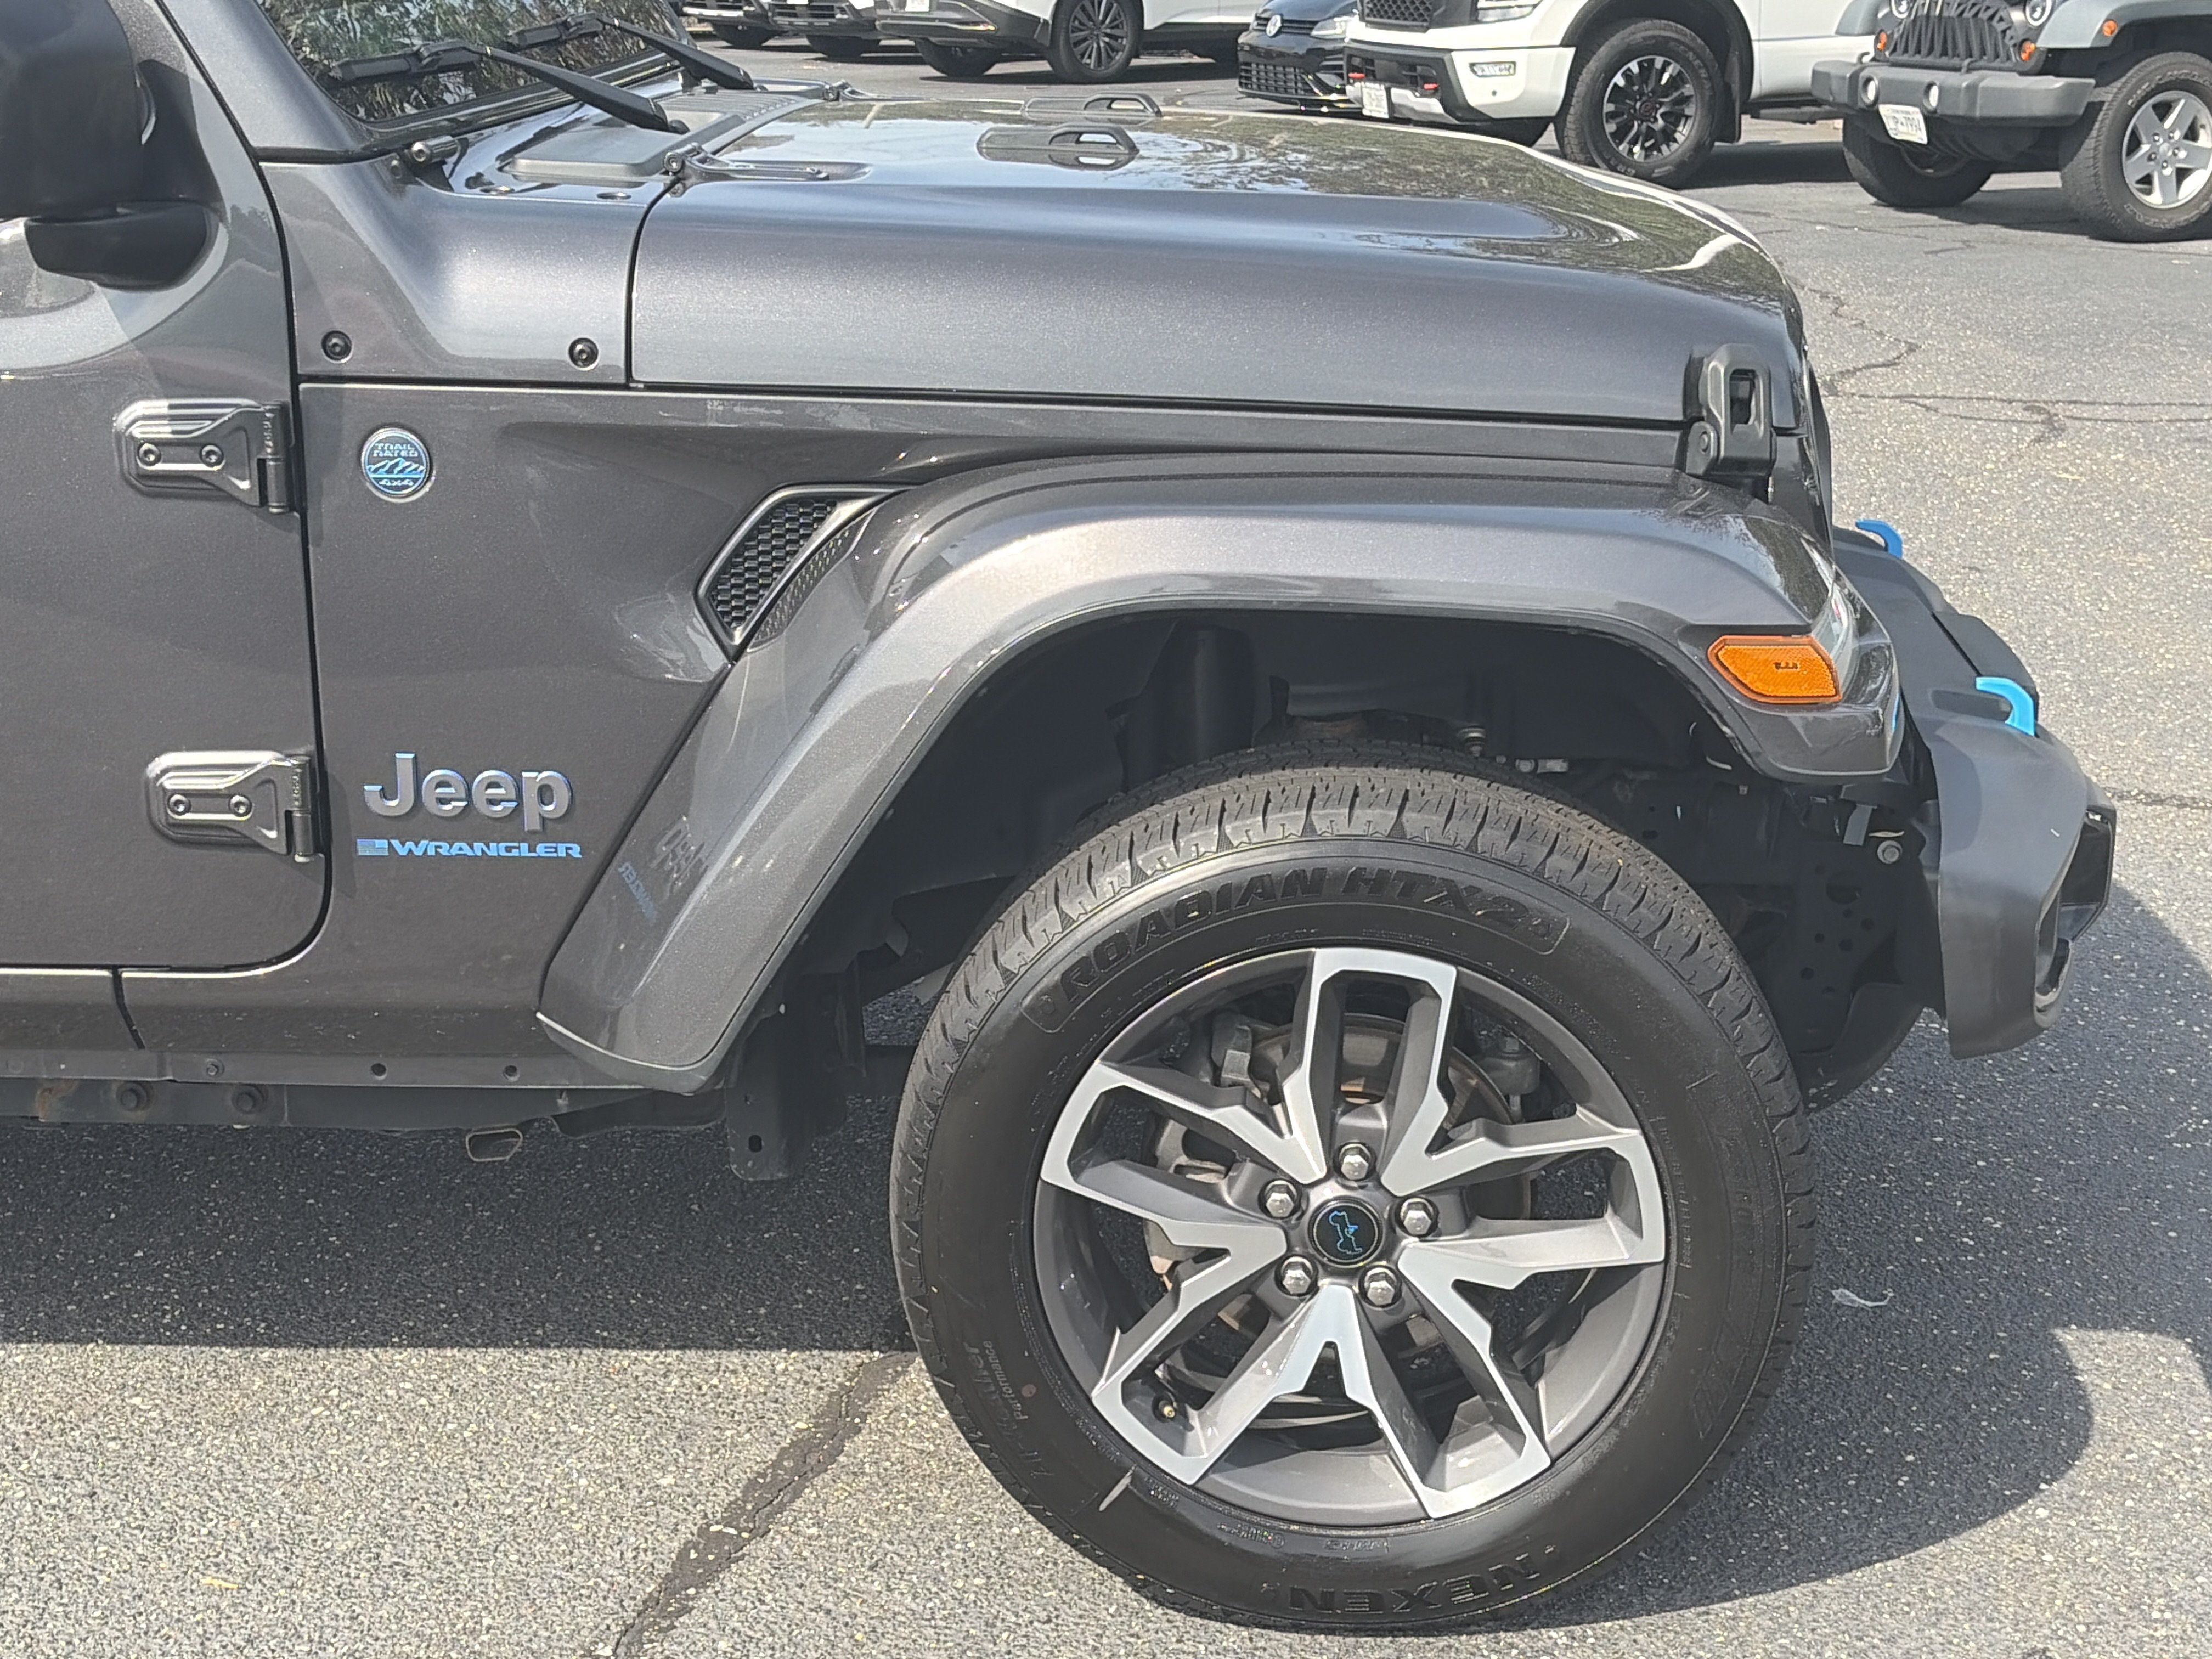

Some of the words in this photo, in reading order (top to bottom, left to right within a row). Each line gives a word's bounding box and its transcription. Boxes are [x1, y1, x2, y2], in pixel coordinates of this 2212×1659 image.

[363, 752, 573, 832] Jeep
[390, 839, 582, 858] WRANGLER
[1060, 867, 1327, 1003] ROADIAN
[1342, 866, 1526, 927] HTX2
[983, 1340, 1029, 1420] Performance
[1290, 1553, 1541, 1613] NEXEN
